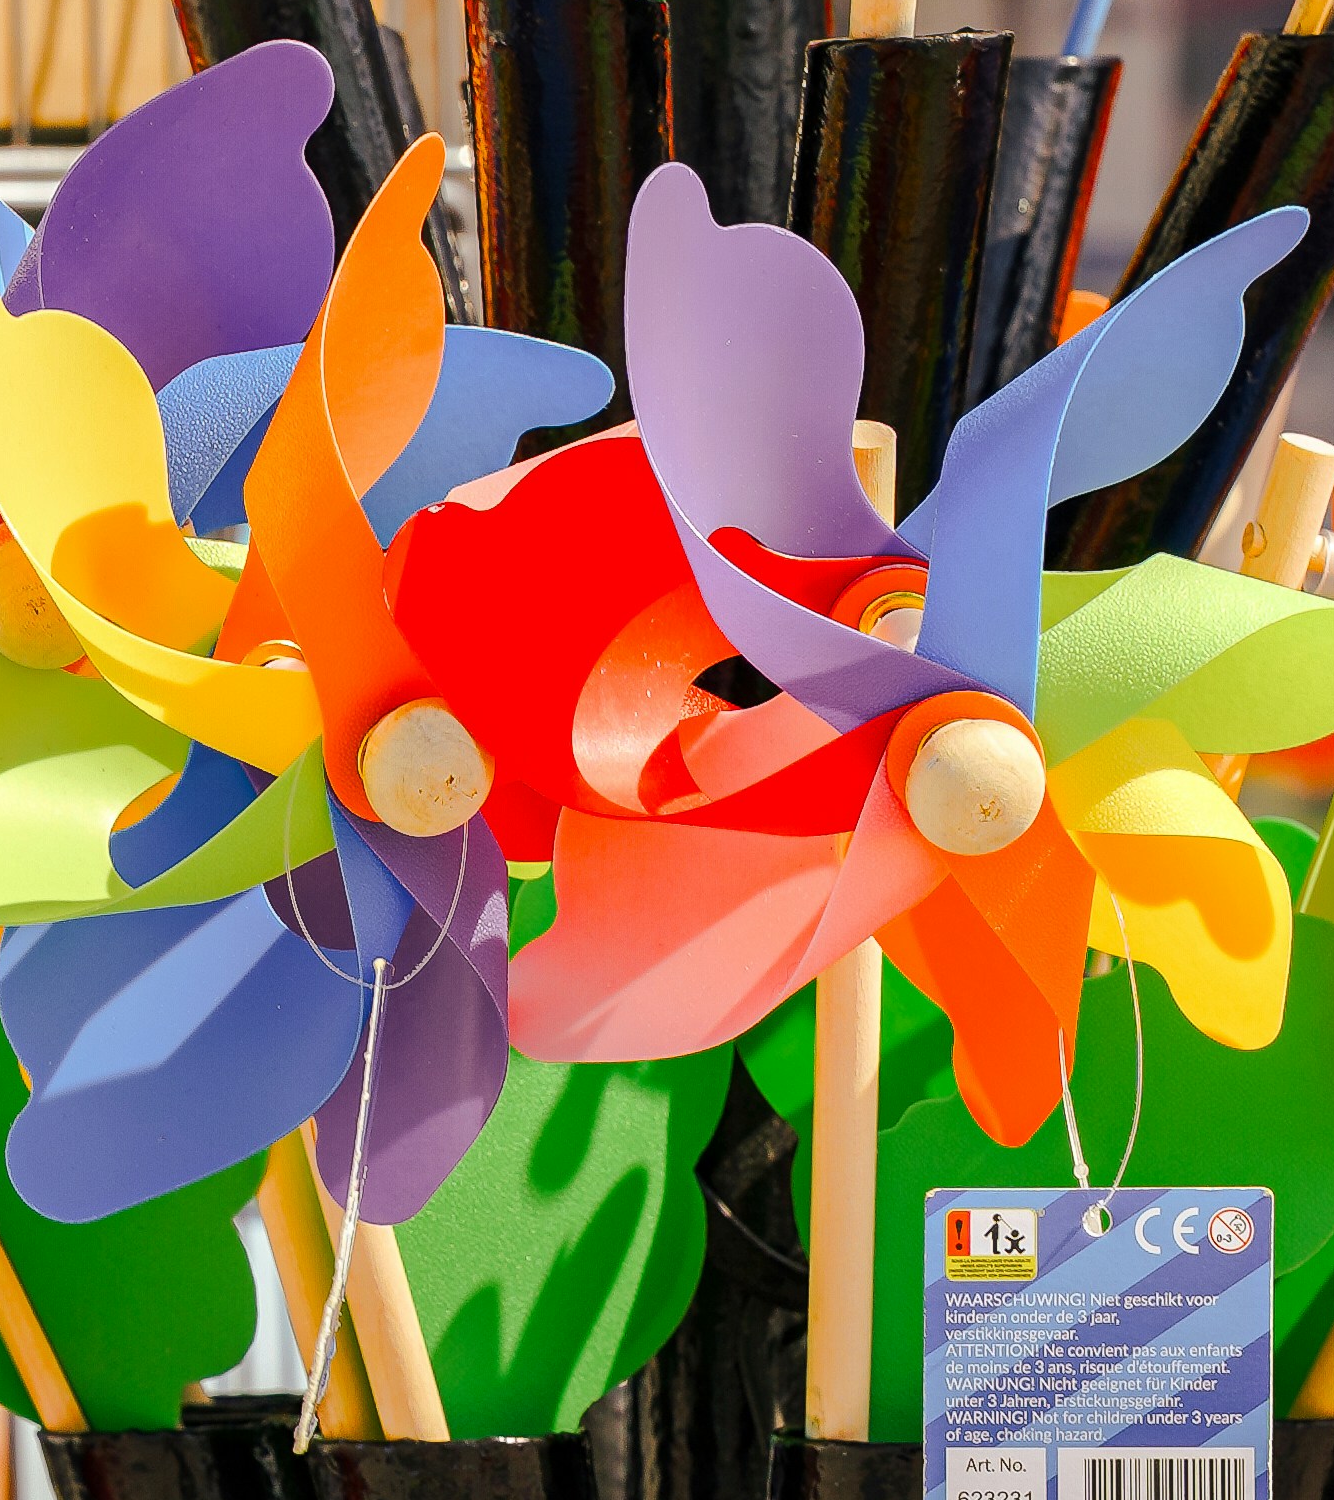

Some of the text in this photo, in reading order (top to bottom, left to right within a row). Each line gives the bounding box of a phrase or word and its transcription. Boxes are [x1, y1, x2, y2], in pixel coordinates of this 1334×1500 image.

[945, 1292, 1219, 1309] WAARSCHUWING! Niet geschikt voor
[945, 1309, 1120, 1326] kinderen onder de 3 jaar,
[945, 1326, 1079, 1342] verstikkingsgevaar.
[945, 1343, 1242, 1360] ATTENTION! Ne convient pas aux enfants
[946, 1360, 1230, 1376] de moins de 3 ans, risque d'étouffement.
[945, 1377, 1218, 1393] WARNUNG! Nicht geeignet für Kinder
[946, 1394, 1184, 1410] unter 3 Jahren, Erstickungsgefahr.
[945, 1410, 1243, 1427] WARNING! Not for children under 3 years
[945, 1427, 1106, 1444] of age, choking hazard.
[966, 1458, 1026, 1472] Art. No.
